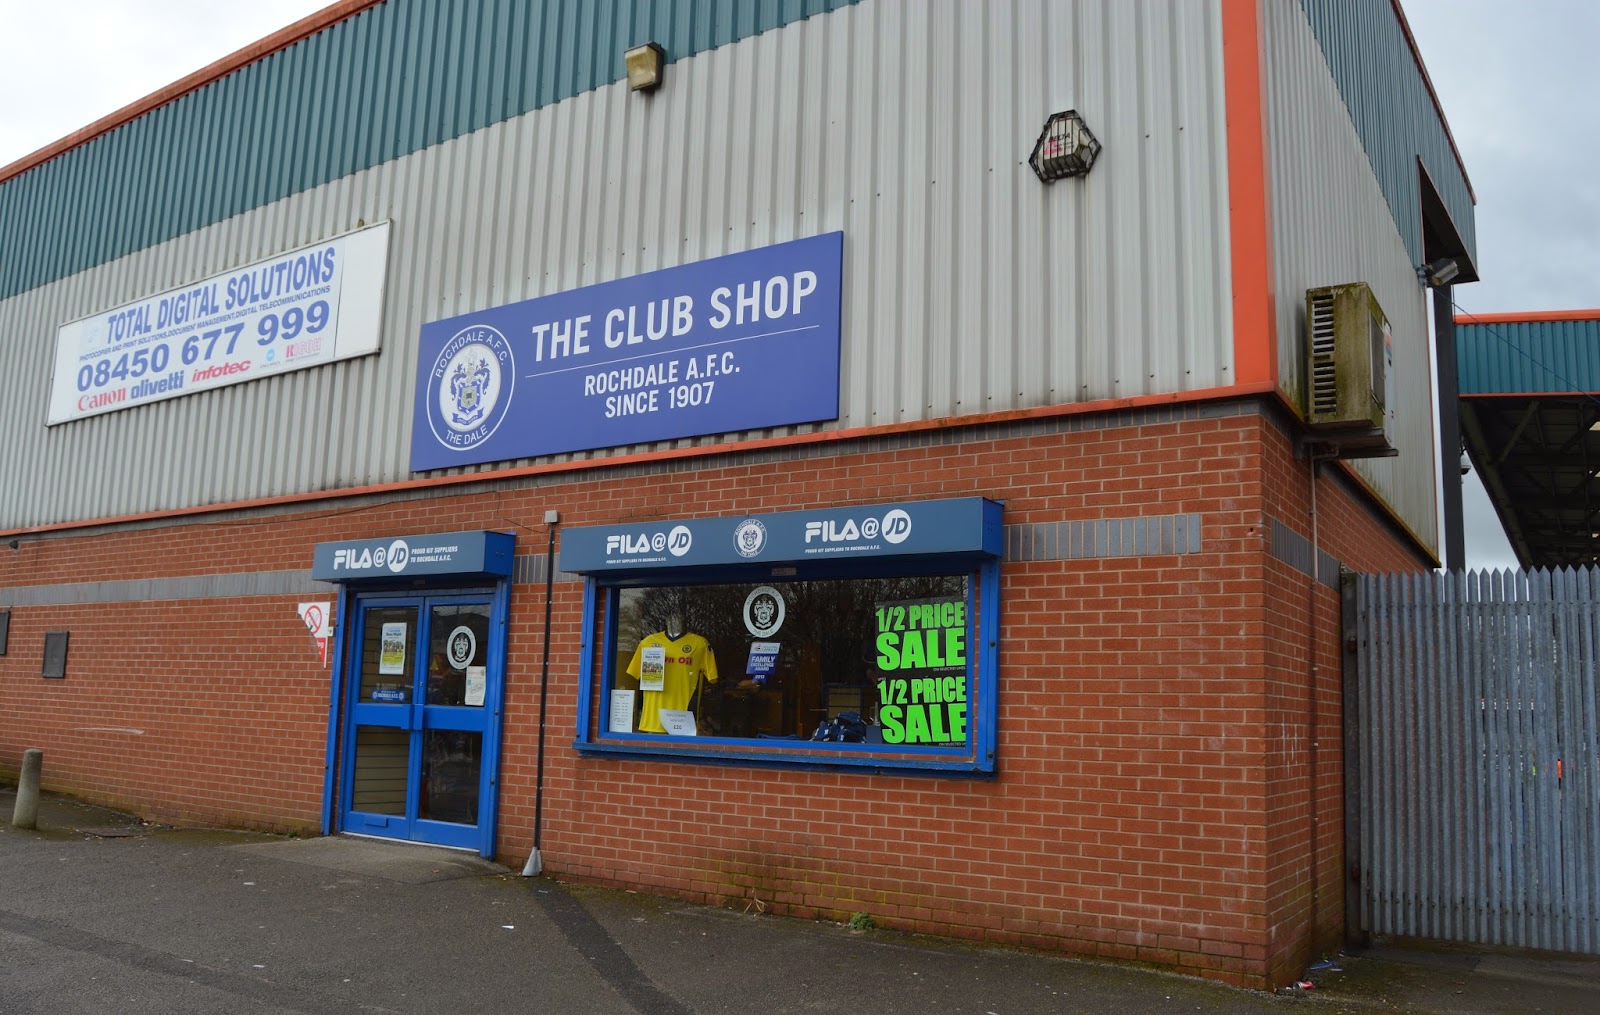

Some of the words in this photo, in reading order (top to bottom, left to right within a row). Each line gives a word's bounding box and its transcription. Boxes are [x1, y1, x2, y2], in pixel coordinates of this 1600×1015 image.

[107, 304, 152, 344] TOTAL
[157, 283, 219, 330] DIGITAL
[225, 247, 335, 310] SOLUTIONS
[532, 314, 592, 362] THE
[604, 295, 694, 349] CLUB
[709, 270, 817, 329] SHOP
[77, 343, 170, 392] 08450
[181, 322, 245, 366] 677
[257, 300, 330, 346] 999
[79, 347, 111, 361] PHOTOCOPIER
[111, 344, 122, 353] AND
[122, 339, 137, 349] PRINT
[259, 285, 331, 312] TELECOMMUNICATIONS
[435, 331, 485, 378] ROCHDALE
[584, 360, 679, 397] ROCHDALE
[686, 351, 740, 380] A.F.C.
[77, 387, 127, 412] Canon
[130, 369, 185, 399] olivetti
[191, 360, 252, 382] infotec
[604, 389, 659, 418] SINCE
[668, 381, 715, 409] 1907
[445, 429, 463, 445] THE
[463, 424, 488, 445] DALE
[875, 606, 906, 632] 1/2
[909, 602, 965, 629] PRICE
[876, 627, 966, 671] SALE
[877, 679, 908, 705] 1/2
[911, 676, 966, 704] PRICE
[880, 703, 967, 744] SALE
